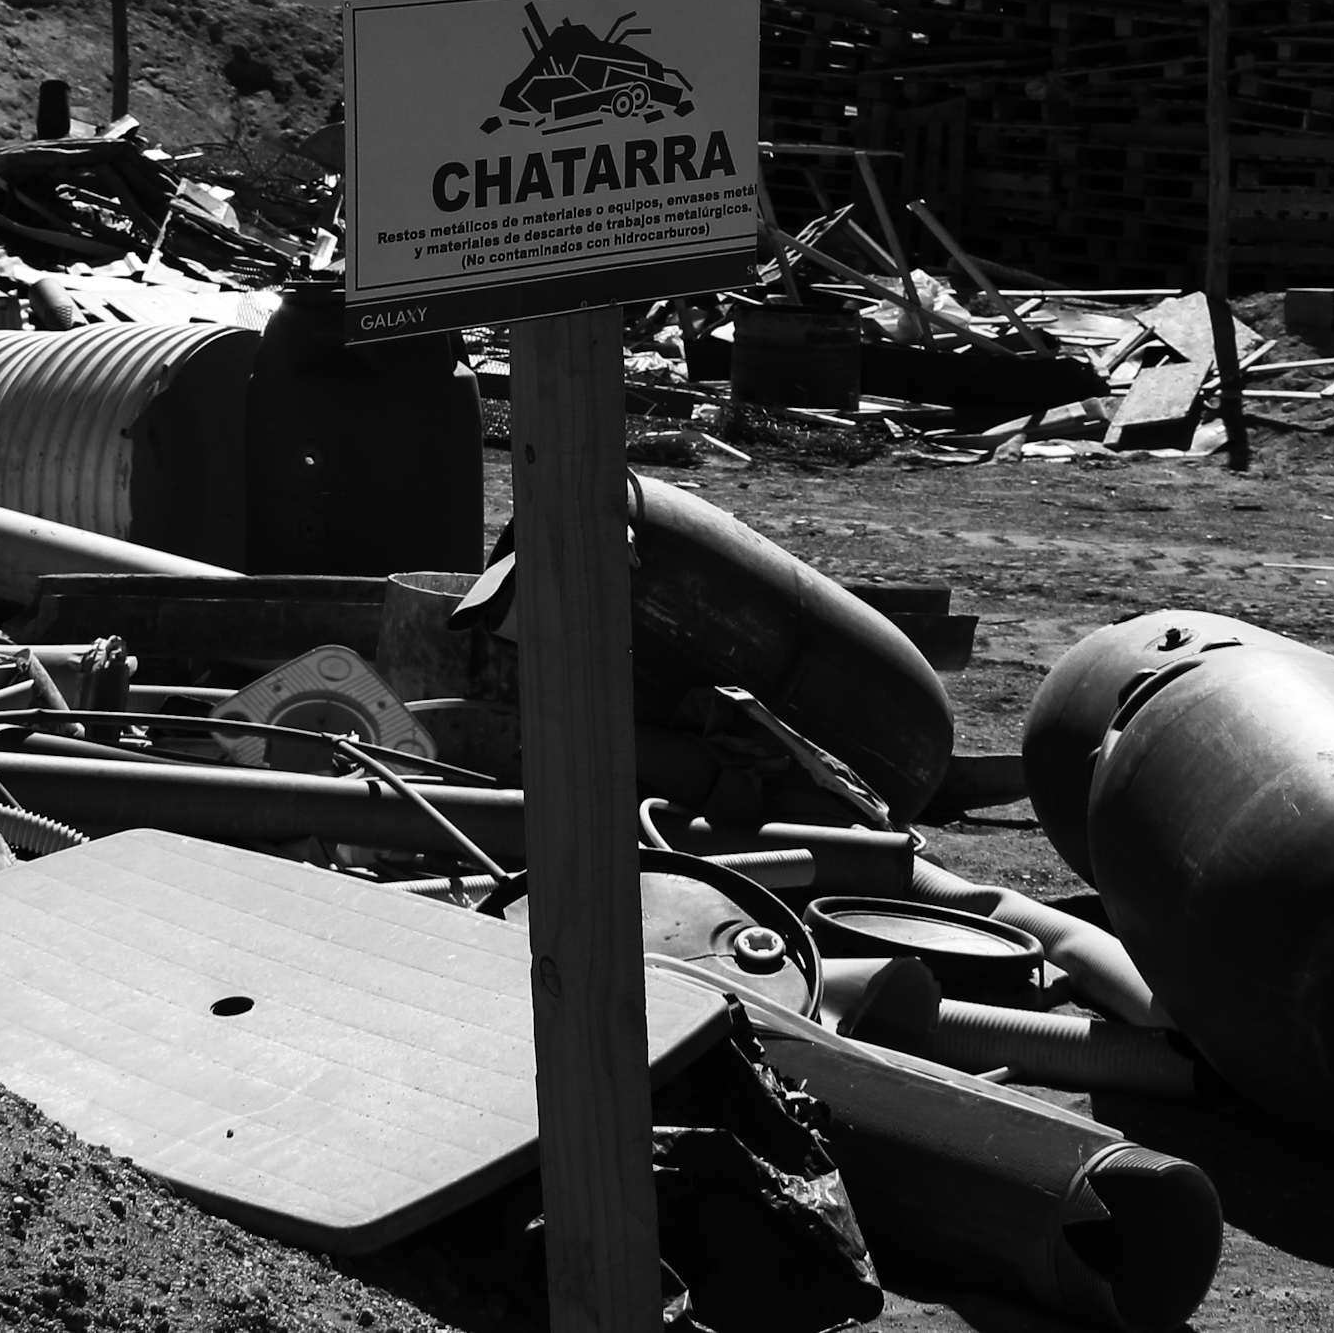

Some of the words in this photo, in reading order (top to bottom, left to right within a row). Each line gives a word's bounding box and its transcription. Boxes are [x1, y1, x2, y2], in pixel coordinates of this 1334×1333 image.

[432, 130, 736, 213] CHATARRA
[378, 229, 426, 245] Restos
[430, 219, 498, 238] metálicos
[502, 216, 519, 228] de
[522, 206, 592, 226] materiales
[596, 206, 604, 215] o
[608, 198, 663, 215] equipos,
[666, 190, 720, 206] envases
[414, 247, 423, 259] y
[426, 236, 500, 255] materiales
[504, 231, 520, 244] de
[524, 224, 583, 242] descarte
[586, 220, 602, 233] de
[606, 213, 661, 230] trabajos
[664, 203, 752, 223] metalúrgicos.
[461, 253, 485, 270] (No
[489, 241, 583, 263] contaminados
[586, 237, 610, 249] con
[614, 222, 710, 245] hidrocarburos)
[360, 306, 428, 331] GALAXY
